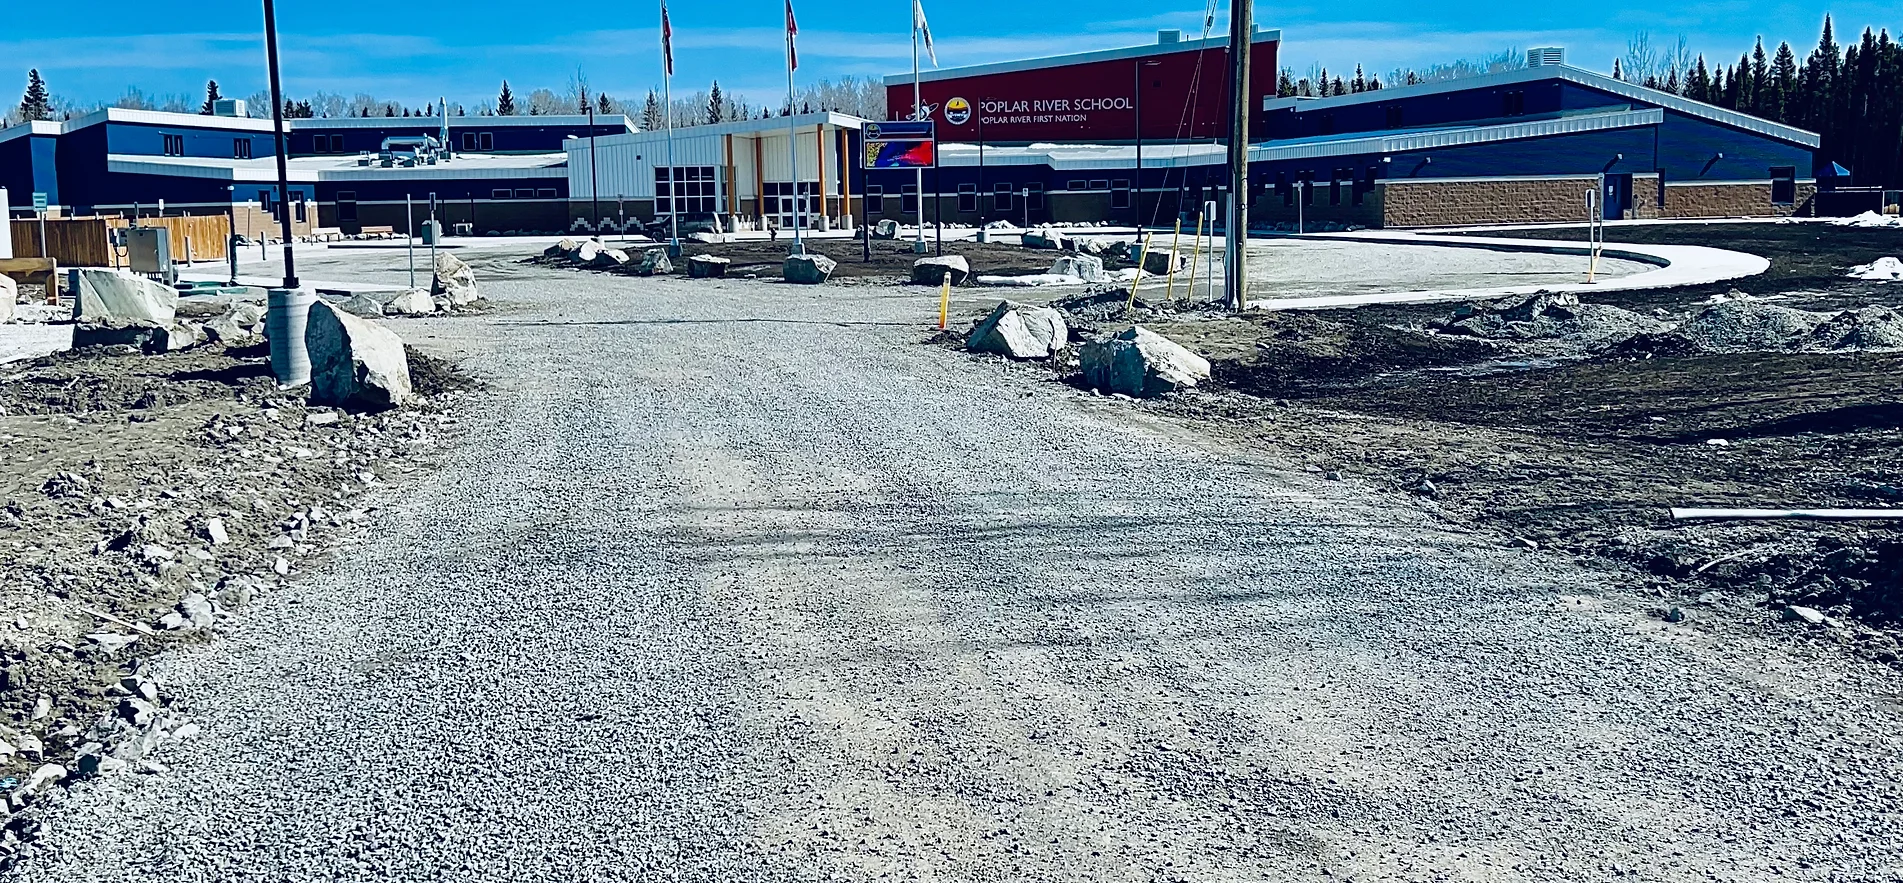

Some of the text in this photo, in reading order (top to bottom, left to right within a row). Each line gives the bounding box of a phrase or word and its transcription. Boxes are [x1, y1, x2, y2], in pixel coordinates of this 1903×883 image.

[1033, 99, 1070, 112] RIVER
[1074, 97, 1133, 111] SCHOOL
[981, 114, 1087, 124] OPLAR RIVER FIRST NATION
